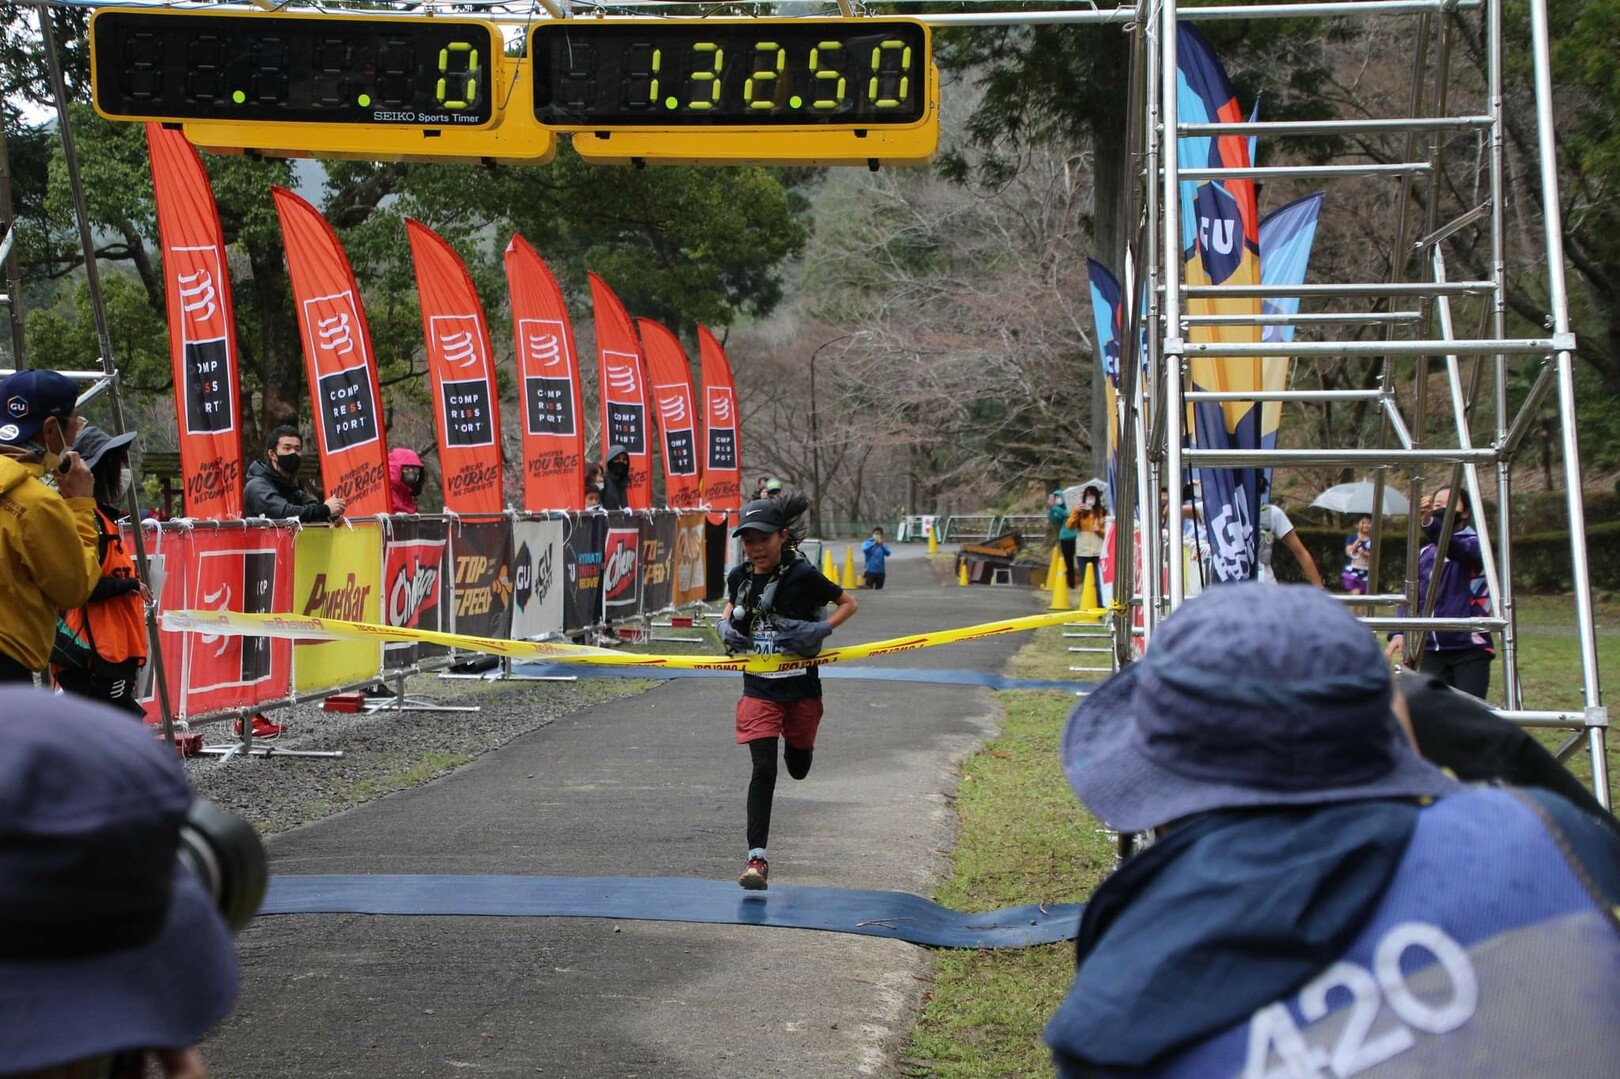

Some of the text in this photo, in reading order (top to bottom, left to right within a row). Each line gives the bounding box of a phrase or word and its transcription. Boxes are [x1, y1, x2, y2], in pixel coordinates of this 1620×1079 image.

[373, 111, 480, 124] SEIKO Sports Timer
[330, 384, 359, 401] COMP
[450, 394, 479, 405] COMP
[537, 389, 562, 399] CMP
[10, 402, 26, 411] GU
[333, 400, 362, 417] RESS
[336, 417, 365, 434] PORT
[354, 462, 385, 492] RACE
[455, 556, 488, 584] TOP
[516, 565, 531, 591] GU
[455, 586, 492, 617] SPEED
[1243, 921, 1479, 1079] 420
